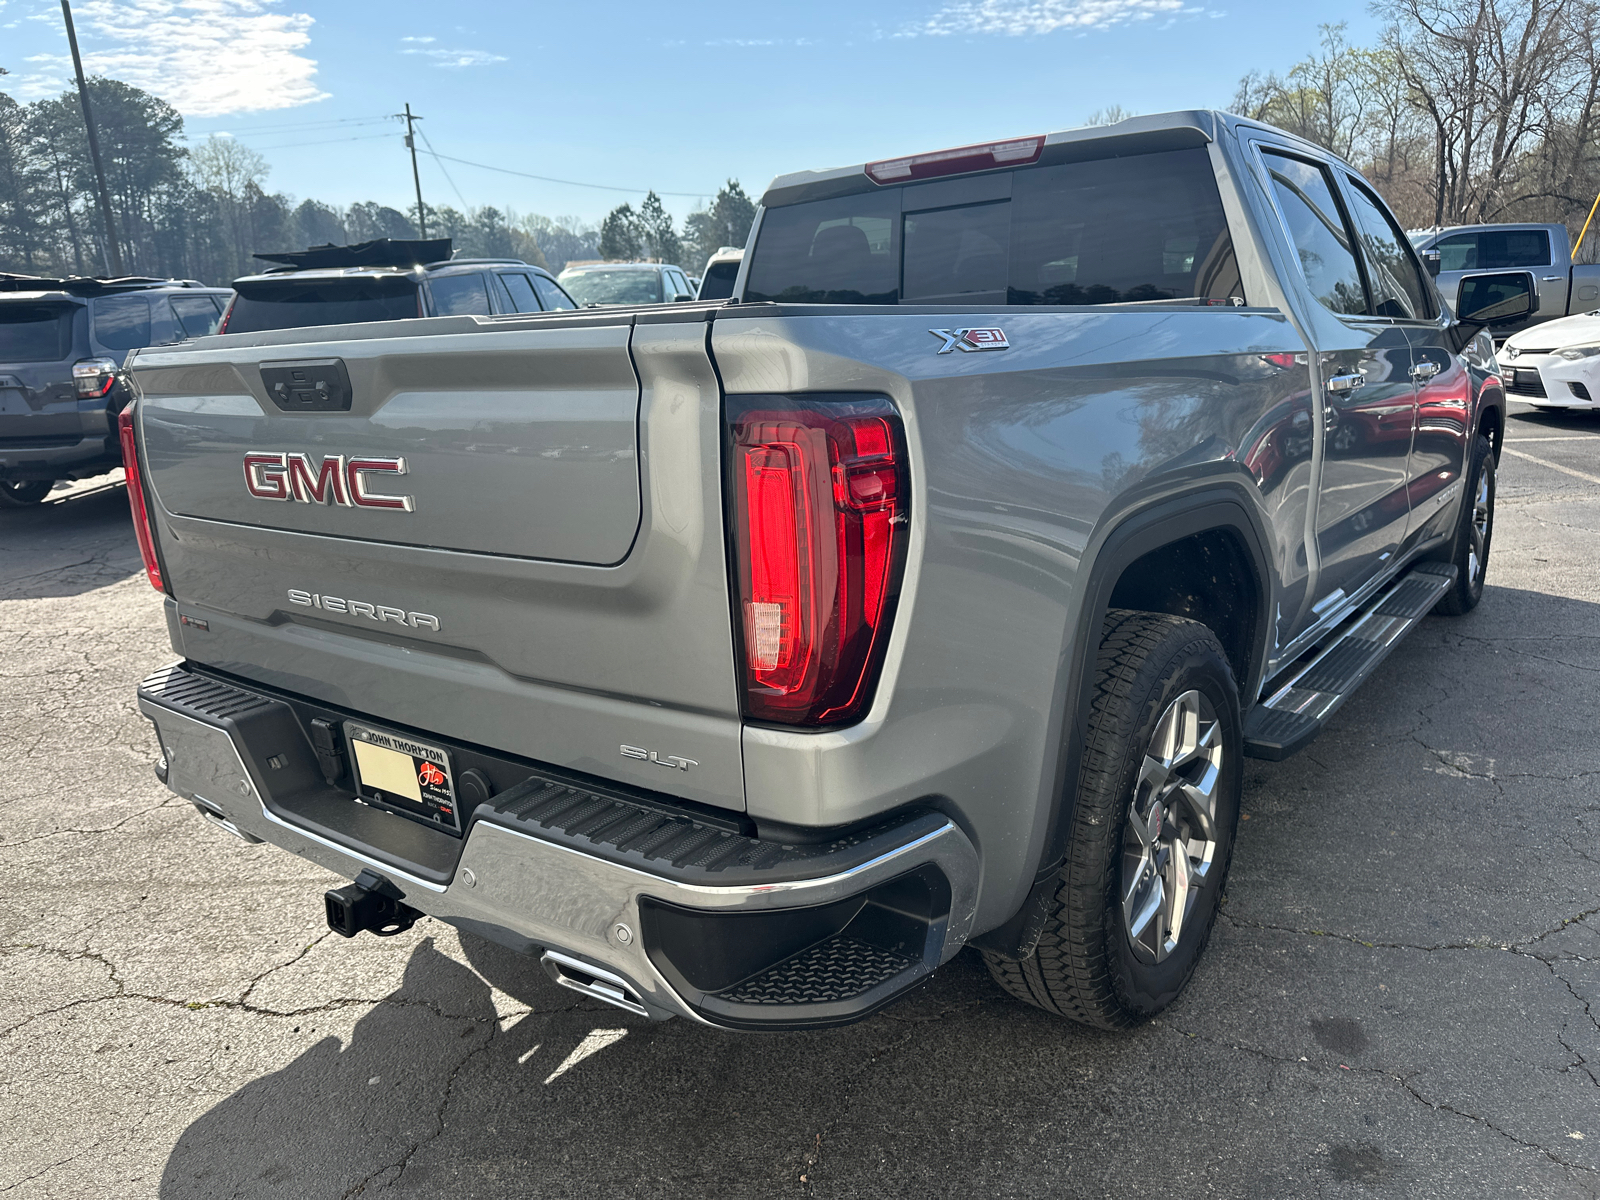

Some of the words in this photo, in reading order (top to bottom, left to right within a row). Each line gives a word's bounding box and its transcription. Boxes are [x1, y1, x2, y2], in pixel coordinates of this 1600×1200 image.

[243, 451, 415, 513] GMC
[287, 588, 441, 632] SIERRA
[368, 731, 391, 747] JOHN
[392, 739, 444, 762] THORNTON
[620, 744, 699, 772] SLT
